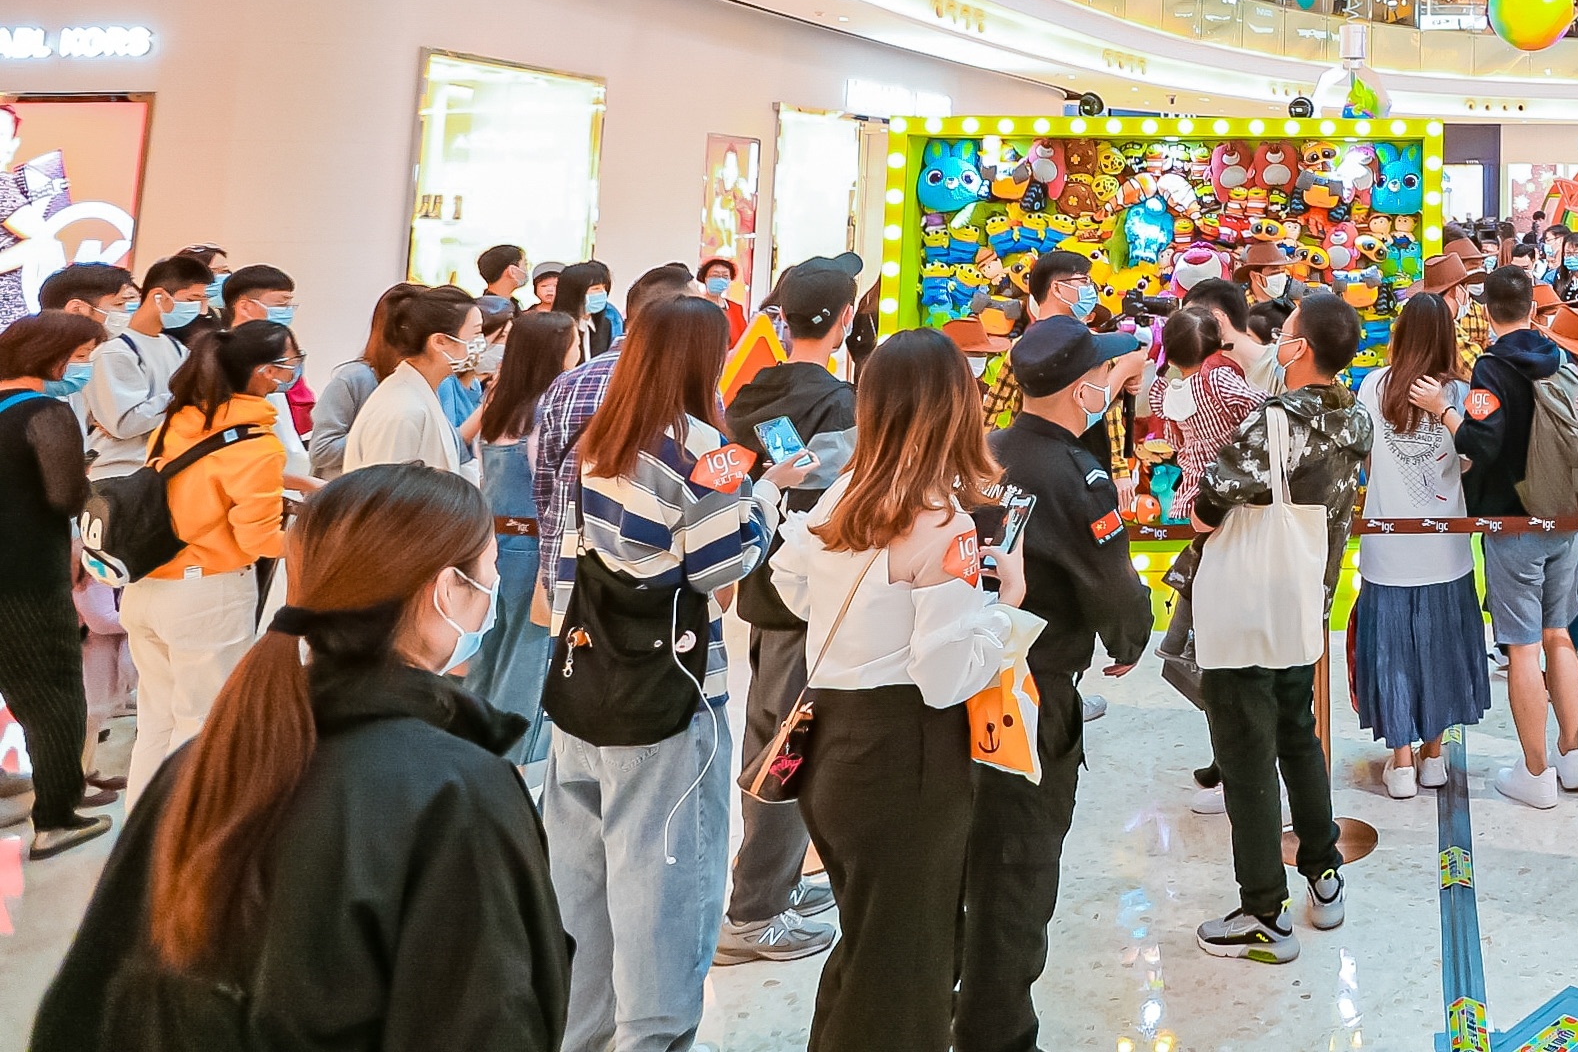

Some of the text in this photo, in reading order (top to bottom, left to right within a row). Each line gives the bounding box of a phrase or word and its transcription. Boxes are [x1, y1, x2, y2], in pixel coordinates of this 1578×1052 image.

[1471, 390, 1490, 408] igc
[705, 449, 740, 476] igc
[759, 927, 786, 946] N
